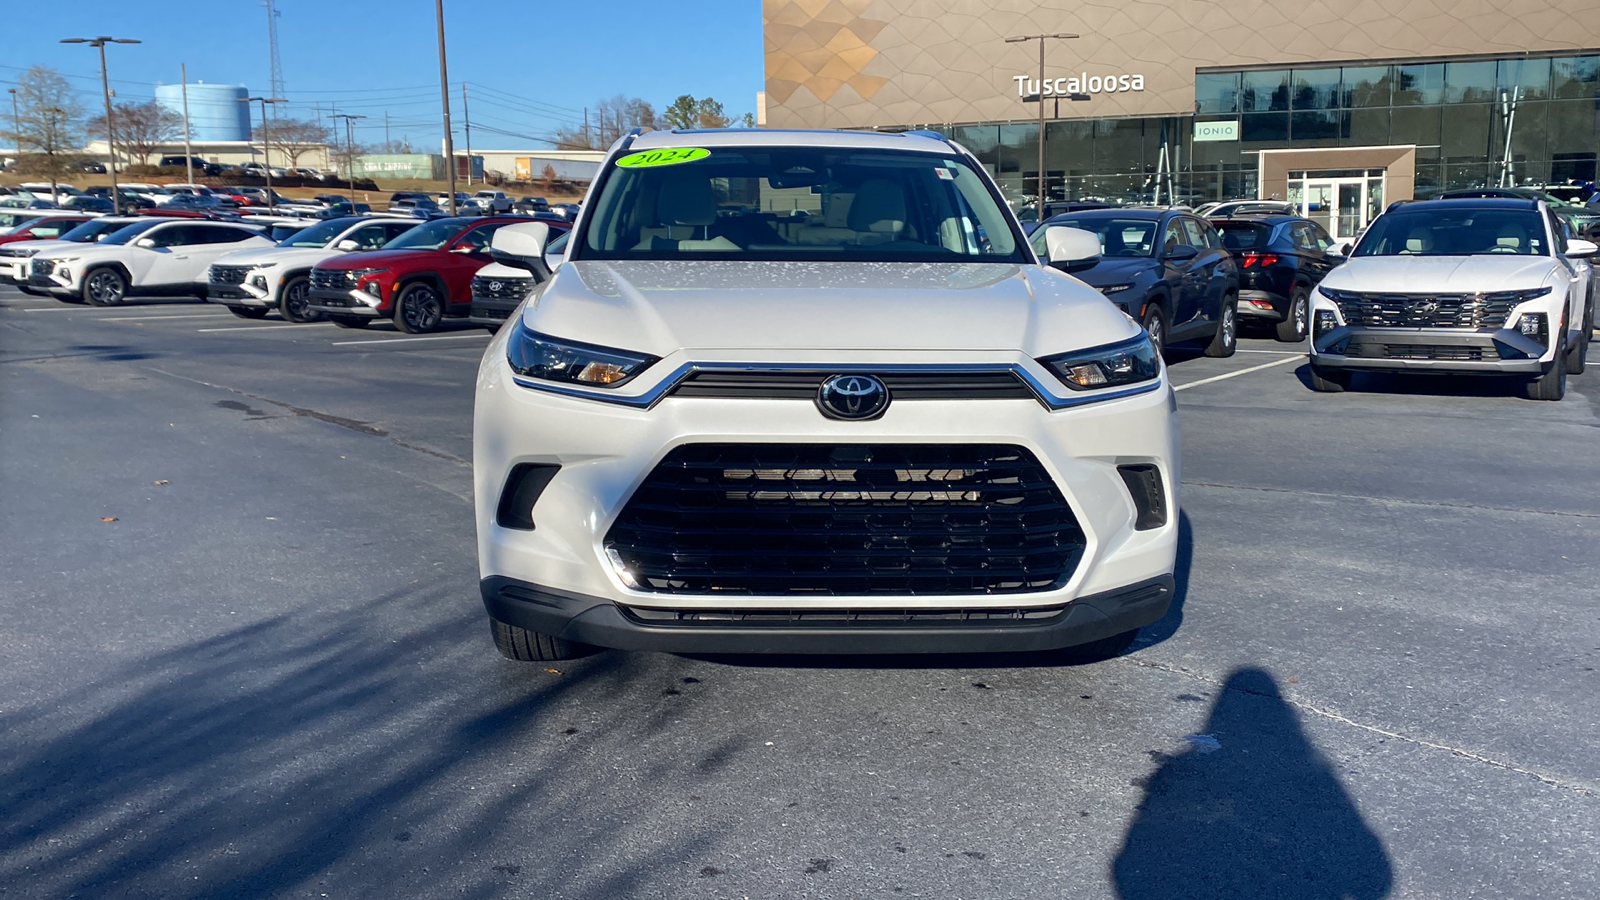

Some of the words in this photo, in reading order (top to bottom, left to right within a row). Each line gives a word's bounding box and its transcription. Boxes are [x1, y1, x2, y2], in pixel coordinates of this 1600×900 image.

[1013, 72, 1145, 97] Tuscaloosa
[1199, 126, 1233, 135] IONIQ
[629, 149, 696, 165] 2024
